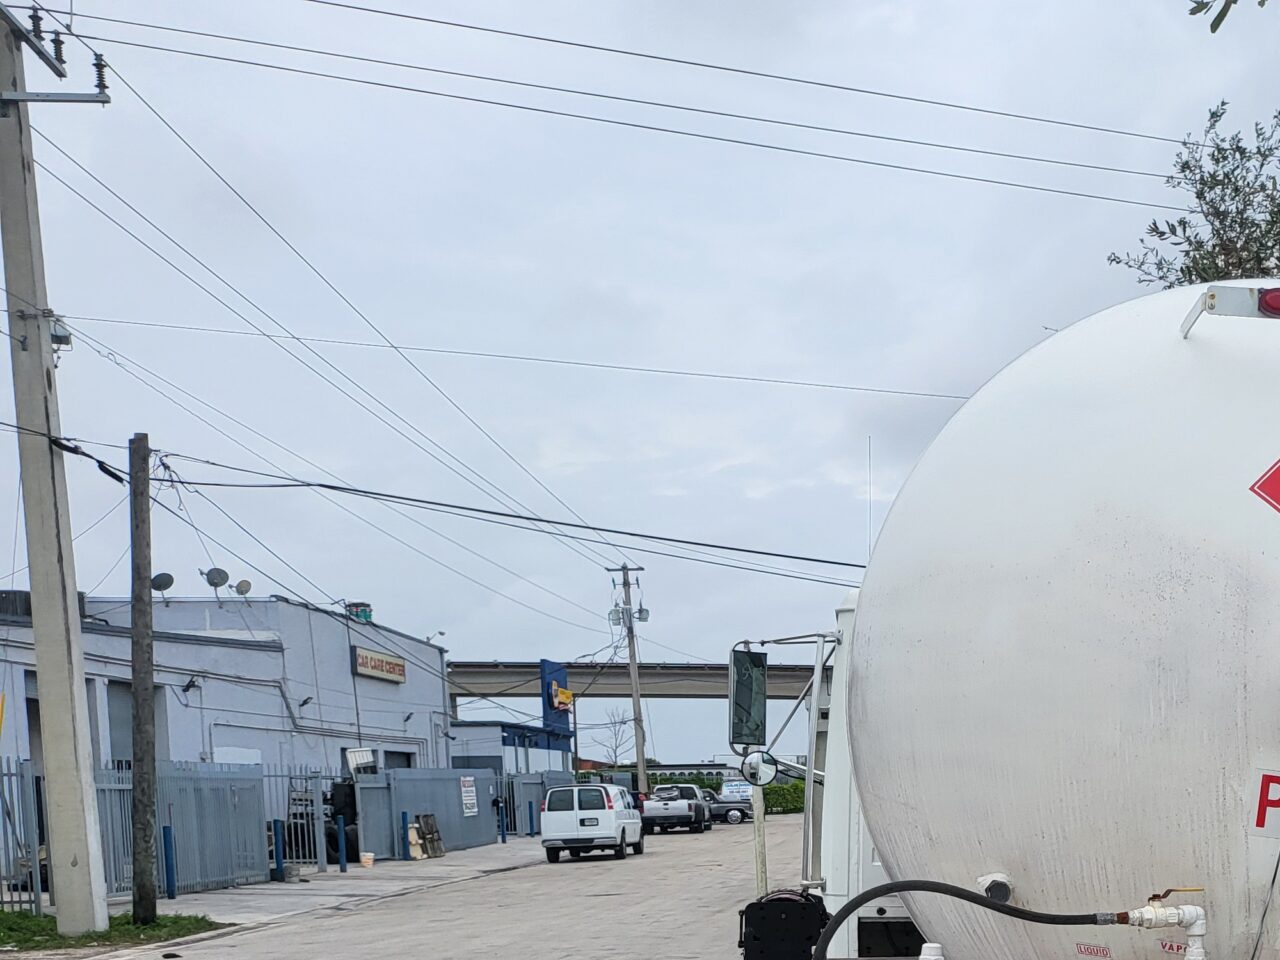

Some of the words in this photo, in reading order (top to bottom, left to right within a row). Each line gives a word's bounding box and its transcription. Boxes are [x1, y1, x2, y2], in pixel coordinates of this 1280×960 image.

[357, 653, 369, 669] CAR
[370, 656, 385, 673] CARE
[385, 660, 405, 676] CENTER
[1079, 945, 1108, 956] LIQUID
